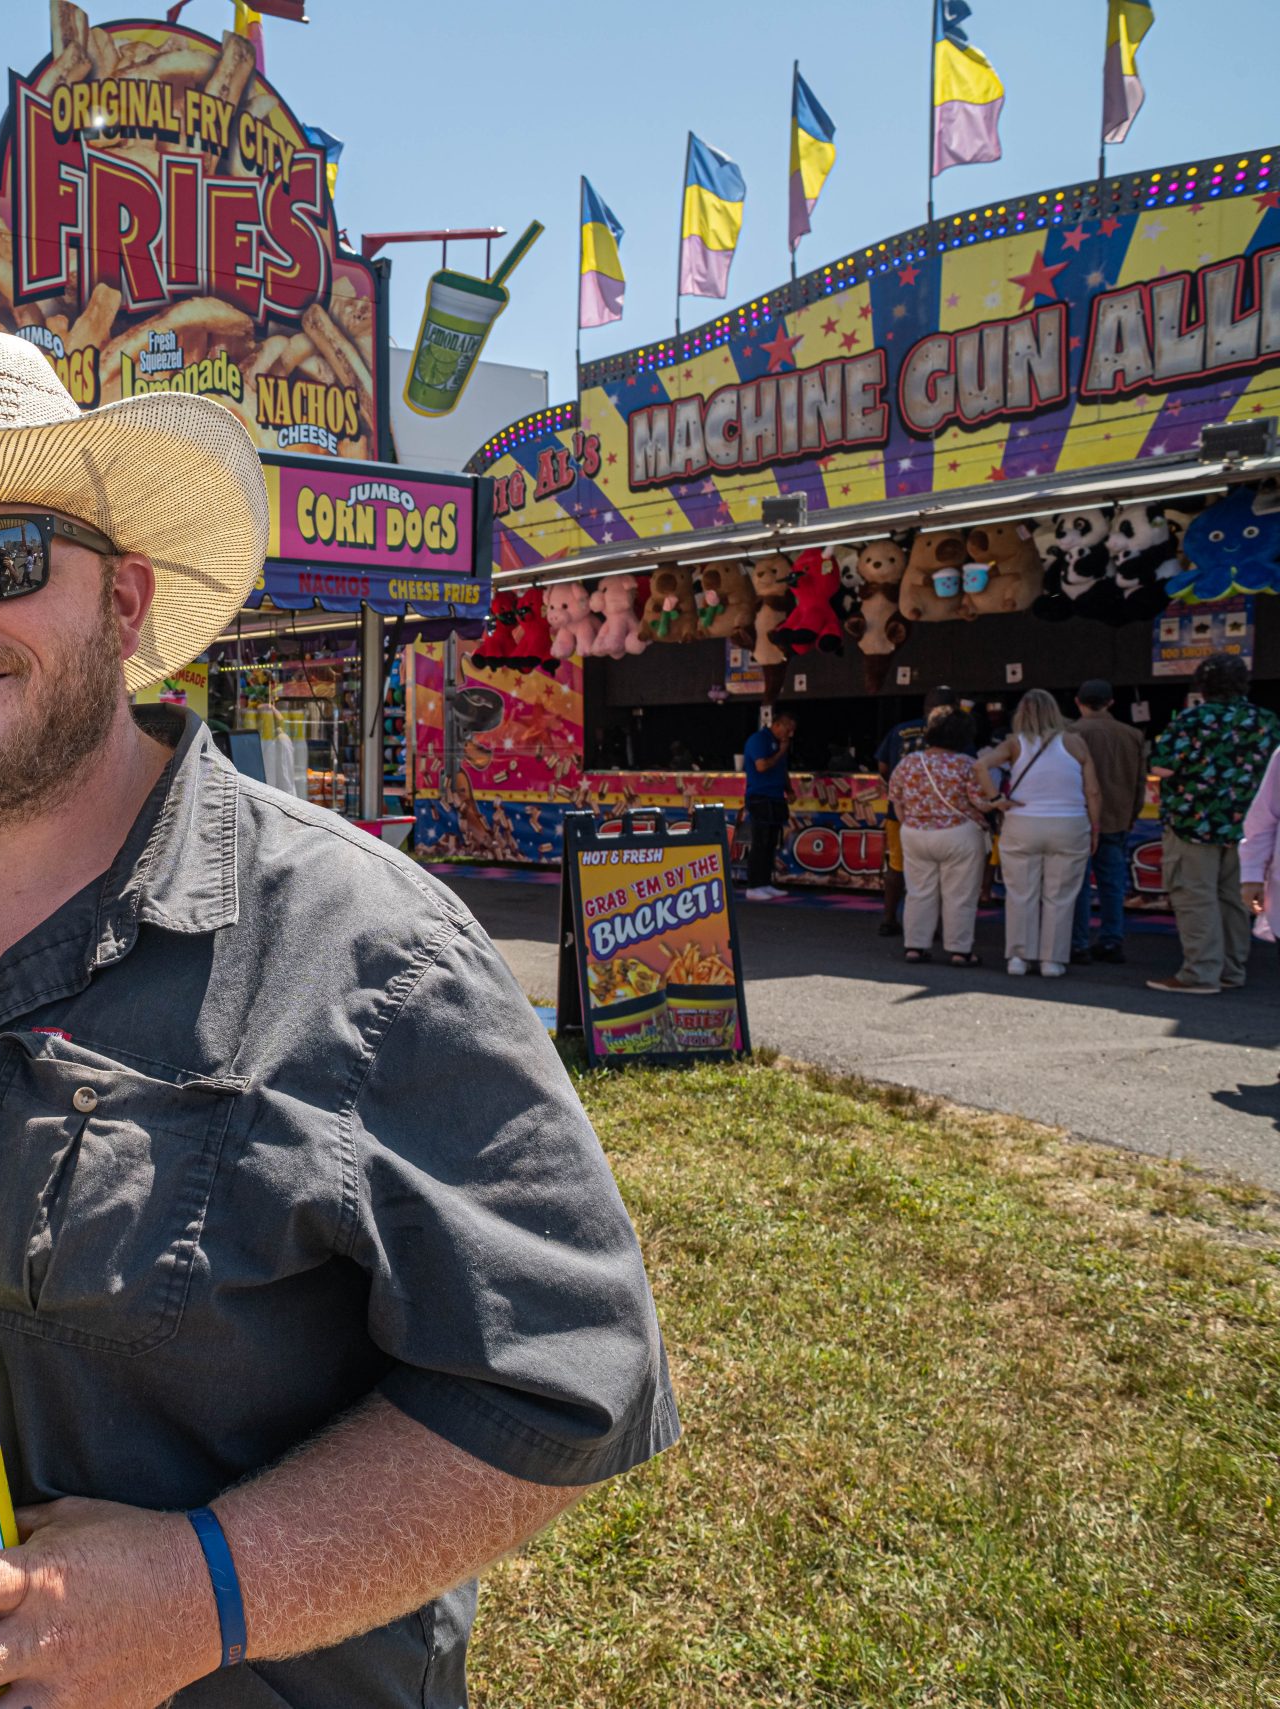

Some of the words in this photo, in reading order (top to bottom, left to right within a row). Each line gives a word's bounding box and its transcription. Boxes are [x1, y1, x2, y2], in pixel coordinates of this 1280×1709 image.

[52, 79, 181, 142] ORIGINAL
[186, 89, 233, 149] FRY
[240, 114, 295, 184] CITY
[19, 88, 328, 322] FRIES
[140, 348, 182, 373] Squeezed
[148, 330, 176, 350] Fresh
[257, 375, 359, 438] NACHOS
[629, 350, 888, 487] MACHINE
[900, 303, 1067, 433] GUN
[277, 424, 338, 456] CHEESE
[347, 483, 416, 512] JUMBO
[494, 471, 526, 516] IG
[535, 432, 600, 499] AL'S
[297, 487, 376, 549] CORN
[386, 503, 458, 555] DOGS
[298, 573, 370, 597] NACHOS
[389, 579, 440, 600] CHEESE
[444, 582, 481, 605] FRIES
[582, 851, 606, 866] HOT
[610, 850, 619, 864] &
[622, 848, 663, 863] FRESH
[584, 888, 627, 917] GRAB
[630, 878, 662, 900] 'EM
[663, 866, 686, 888] BY
[688, 854, 720, 880] THE
[592, 880, 721, 955] BUCKET!
